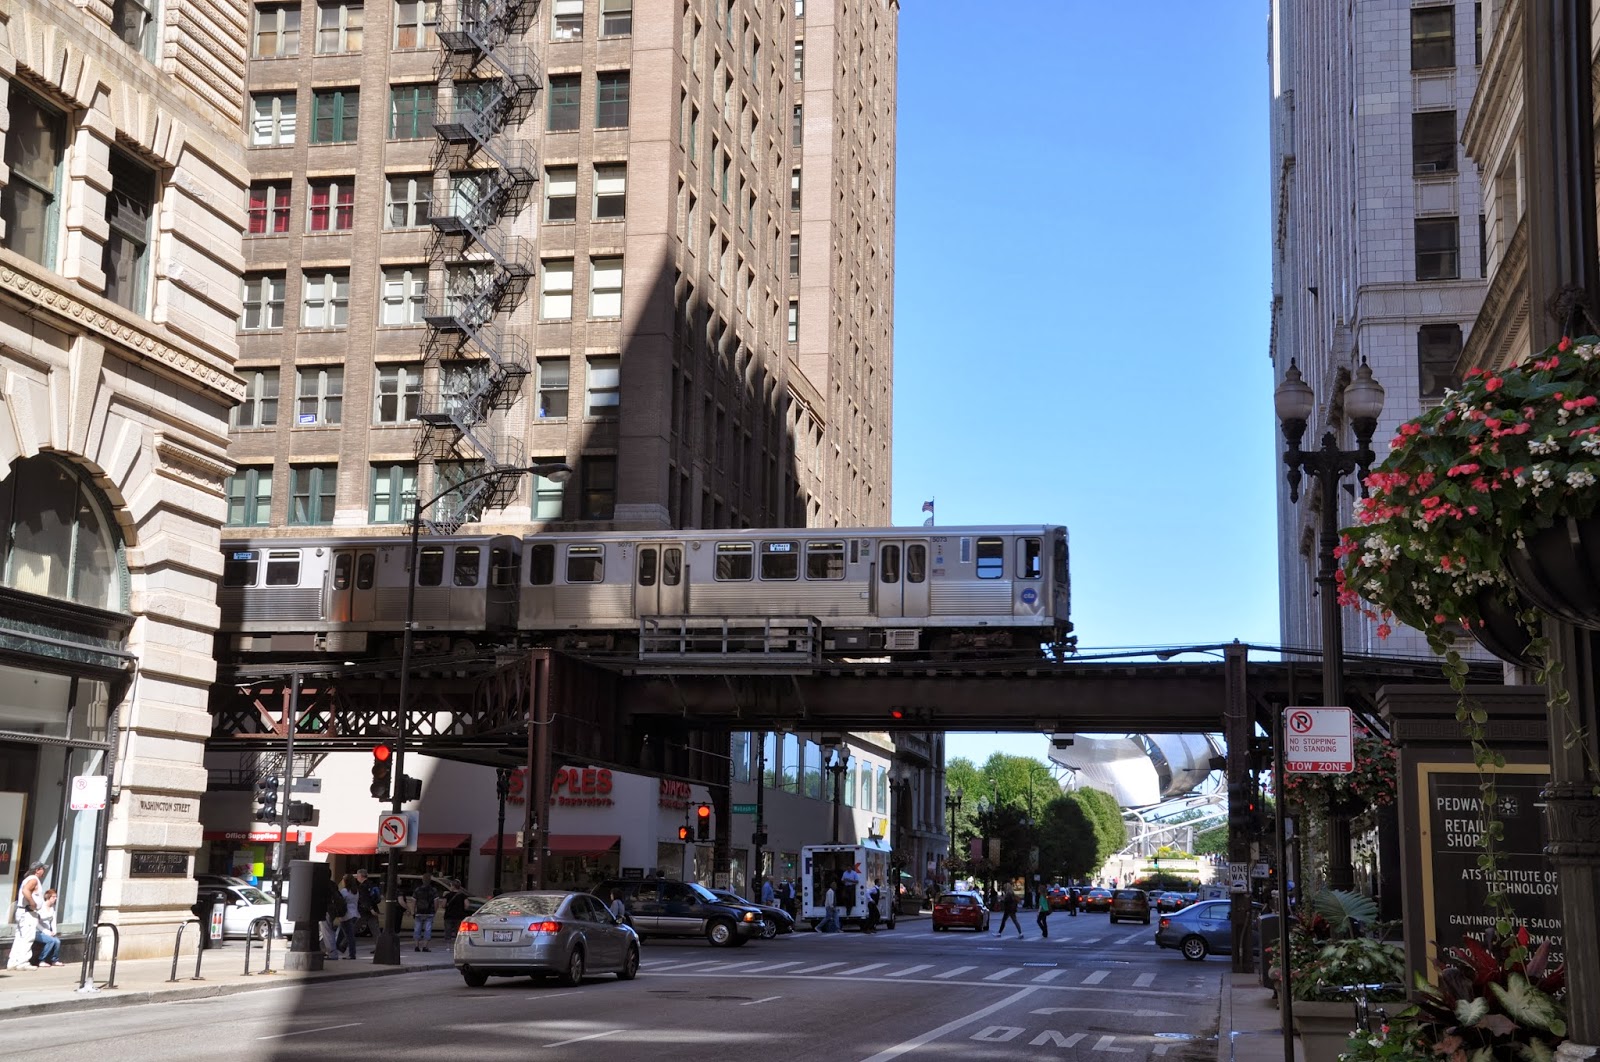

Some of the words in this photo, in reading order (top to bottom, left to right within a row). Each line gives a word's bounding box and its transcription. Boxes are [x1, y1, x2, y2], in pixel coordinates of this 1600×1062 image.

[1291, 762, 1313, 771] TOW
[1318, 762, 1347, 771] ZONE
[509, 769, 612, 793] SPLES
[140, 801, 172, 812] WASHINGTON
[174, 803, 190, 812] STREET
[1437, 798, 1485, 811] PEDWAY
[1445, 819, 1487, 833] RETAIL
[248, 832, 278, 840] Supplies
[1447, 834, 1486, 847] SHOP
[1461, 869, 1482, 880] ATS
[1544, 872, 1557, 882] OF
[1486, 882, 1558, 895] TECHNOLOGY
[1510, 917, 1528, 928] THE
[1532, 918, 1561, 928] SALON
